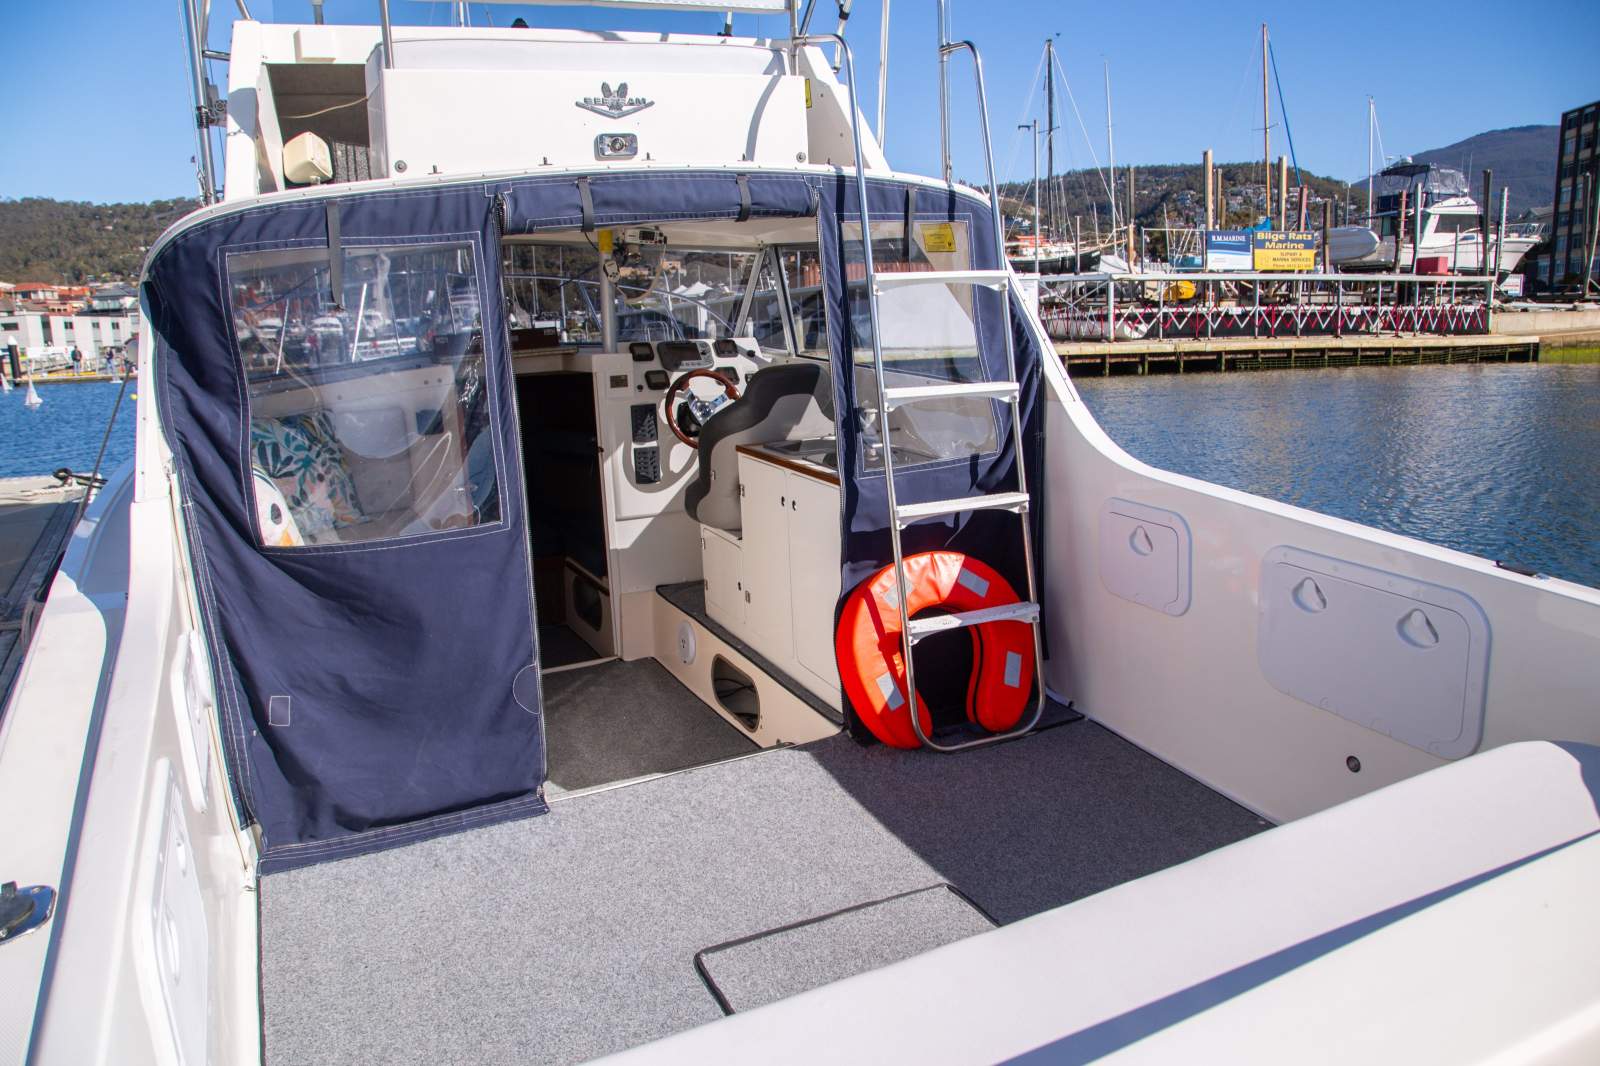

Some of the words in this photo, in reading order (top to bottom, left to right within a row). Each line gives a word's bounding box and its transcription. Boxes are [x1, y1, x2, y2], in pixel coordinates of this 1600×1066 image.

[583, 97, 647, 105] BERAM
[1257, 232, 1286, 242] Bilge
[1289, 232, 1313, 240] Rats
[1265, 241, 1305, 249] Marine
